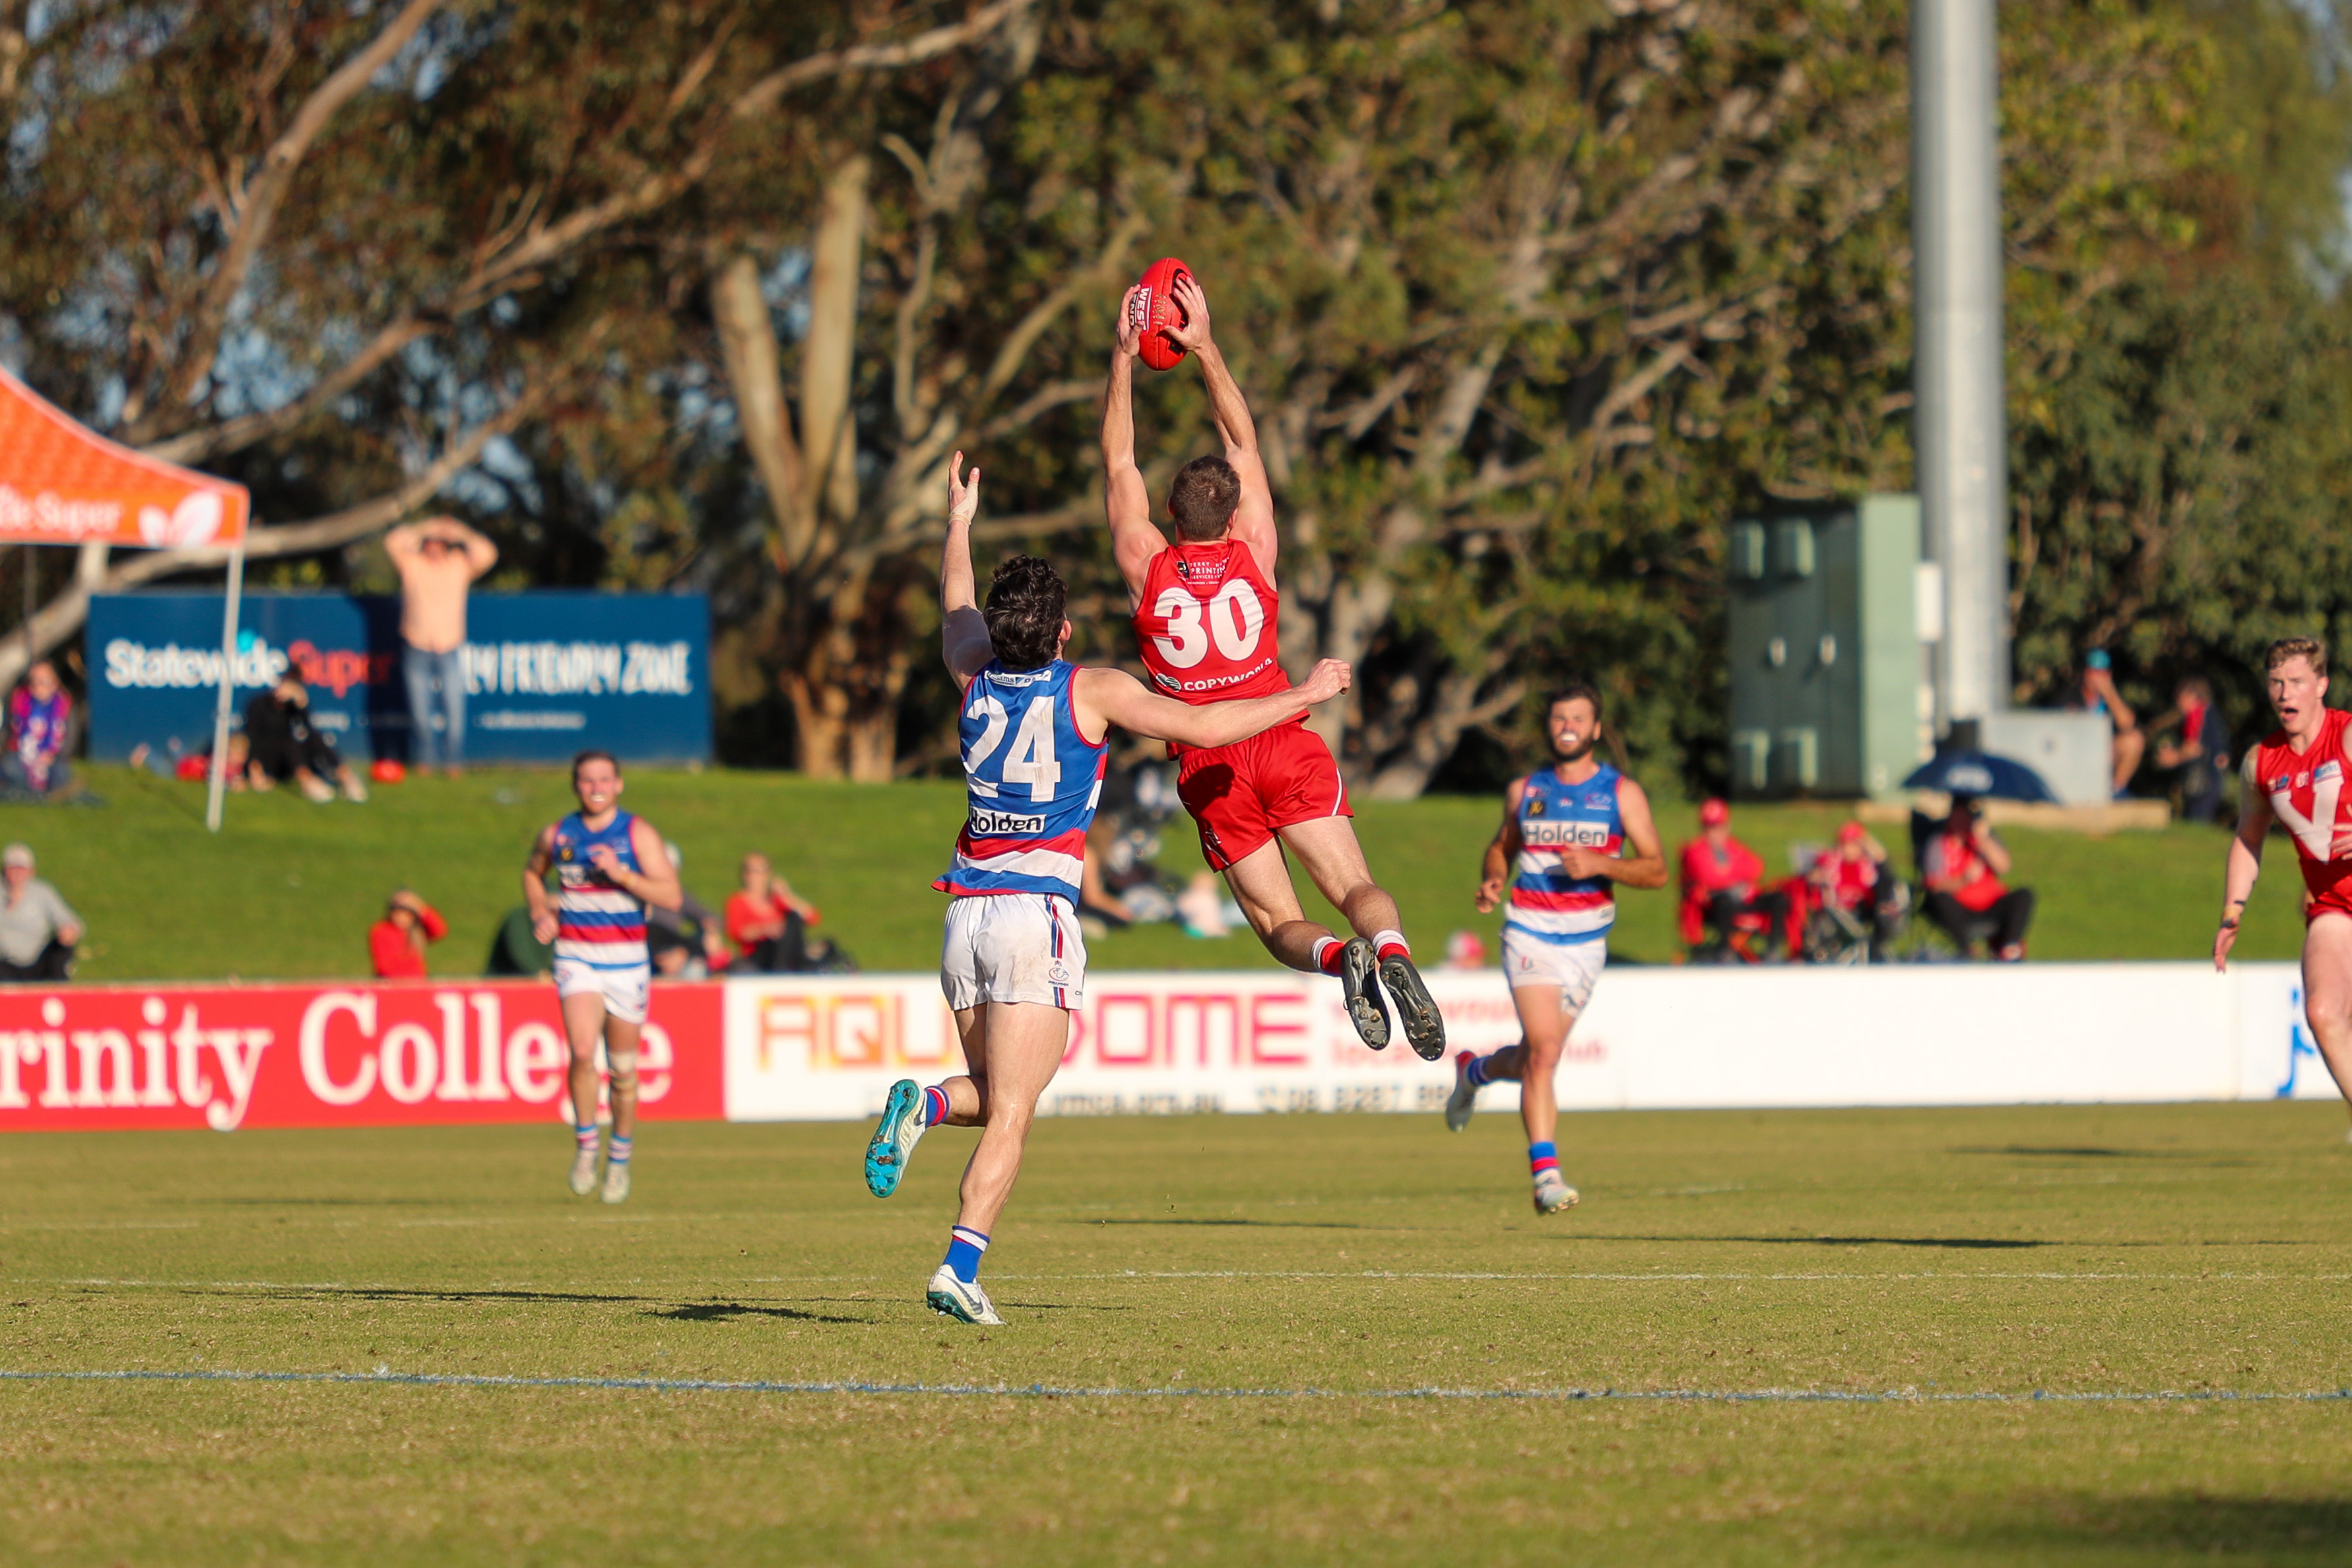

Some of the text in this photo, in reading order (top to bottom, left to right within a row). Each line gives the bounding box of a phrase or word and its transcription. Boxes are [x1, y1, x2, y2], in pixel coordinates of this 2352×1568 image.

[1191, 565, 1226, 574] PRINTIN
[1152, 578, 1264, 669] 30
[105, 630, 289, 688] Statewide
[963, 694, 1061, 802] 24
[971, 810, 1041, 832] Holden
[1525, 824, 1606, 843] Holden
[759, 993, 1309, 1066] AQUDOME
